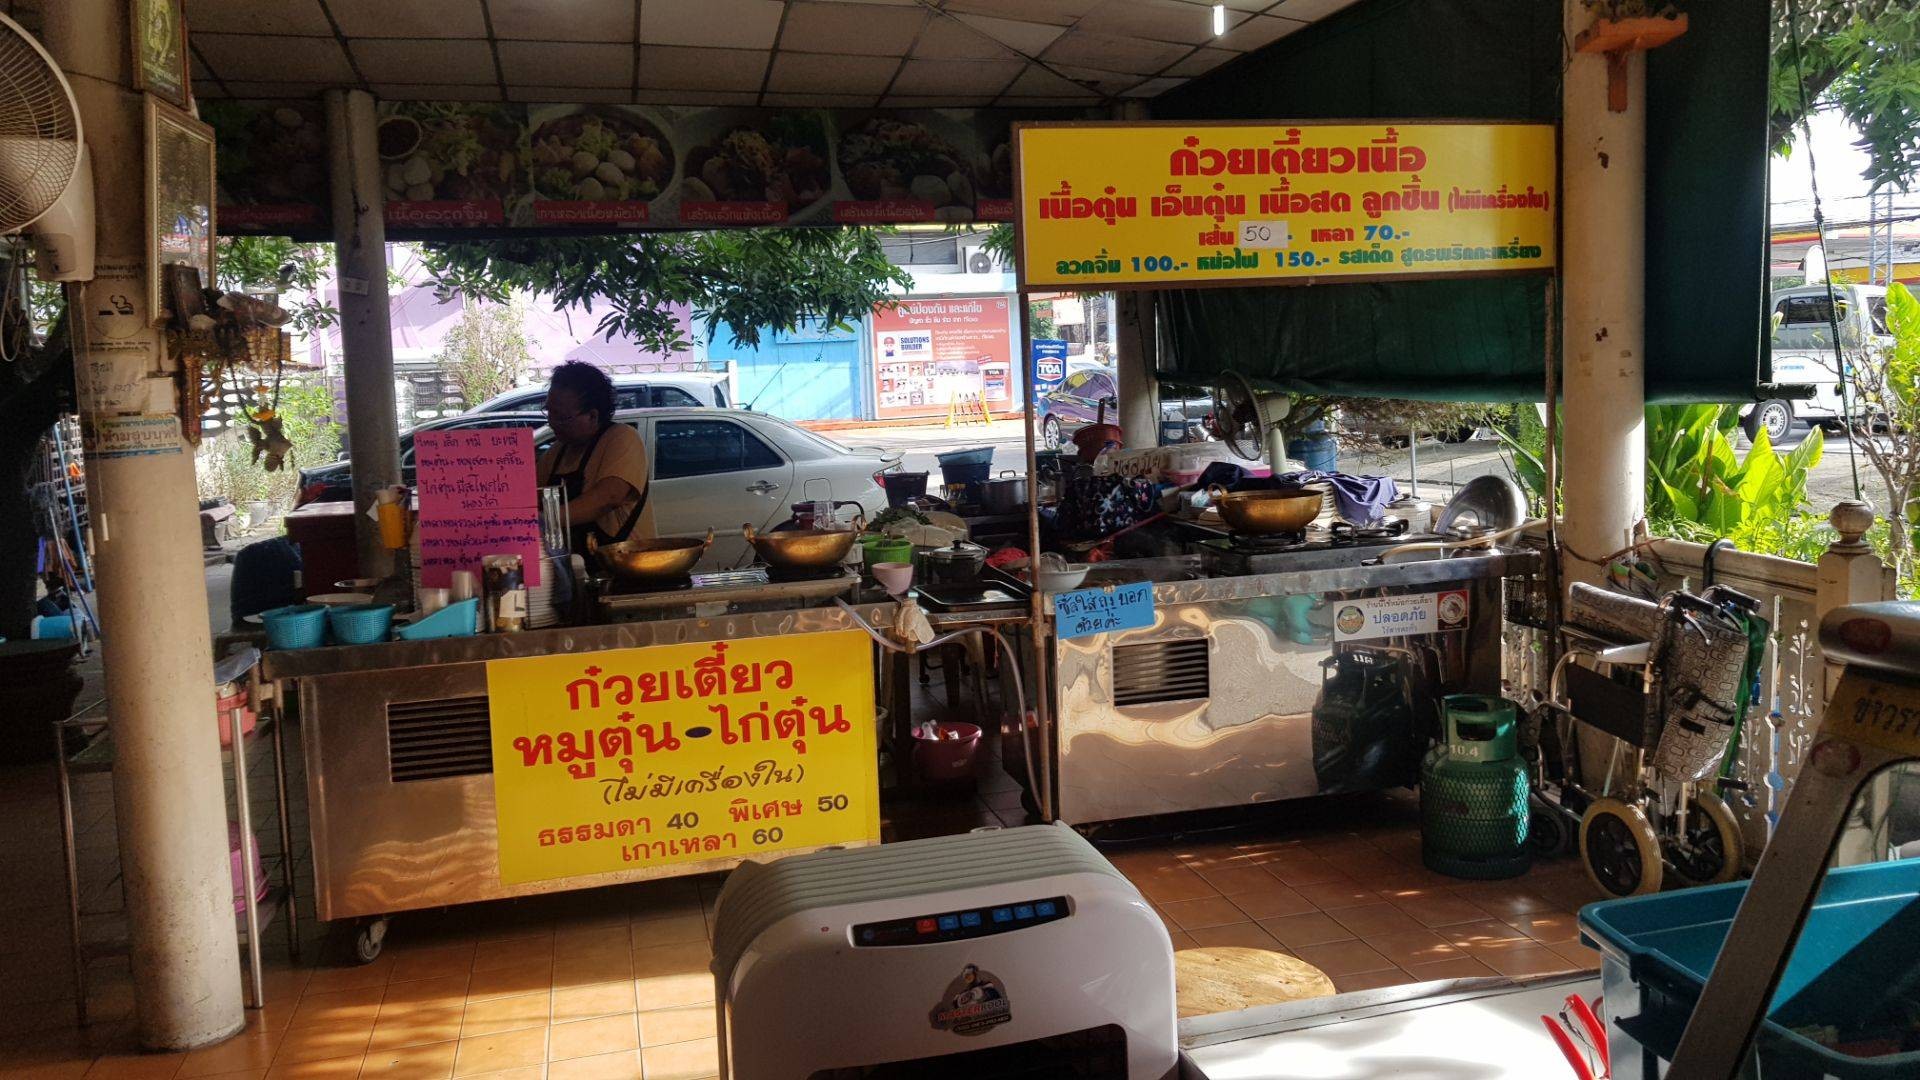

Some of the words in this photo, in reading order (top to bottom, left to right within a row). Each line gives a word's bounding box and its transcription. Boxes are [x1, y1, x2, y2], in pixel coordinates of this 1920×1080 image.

[1170, 127, 1427, 176] ก๋วยเตี๋ยวเนื้อ
[1039, 180, 1137, 225] เนื้อตุ๋น
[1151, 184, 1246, 222] เอ็นตุ๋น
[1259, 176, 1351, 214] เนื้อสด
[1362, 175, 1440, 218] ลูกชิ้น
[1199, 224, 1235, 246] เส้น
[1244, 226, 1271, 242] 50
[1311, 227, 1354, 242] เหลา
[1364, 225, 1410, 241] 70.-
[1056, 248, 1121, 275] ลวกจิ้ม
[1131, 256, 1189, 272] 100.-
[1197, 248, 1259, 271] หม้อไฟ
[1275, 251, 1330, 268] 150.-
[1338, 243, 1394, 264] รสเด็ด
[901, 343, 923, 351] BUILDER
[1038, 364, 1061, 374] TOA
[1373, 607, 1427, 624] ปลอดภัย
[565, 642, 794, 711] ก๋วยเตี๋ยว
[1449, 744, 1478, 757] 10.4
[598, 759, 806, 806] (ไม่มีเครื่องใน)
[538, 815, 652, 847] ธรรมดา
[666, 811, 699, 830] 40
[729, 797, 803, 823] พิเศษ
[818, 793, 849, 812] 50
[621, 829, 738, 862] เกาเหลา
[752, 826, 784, 845] 60
